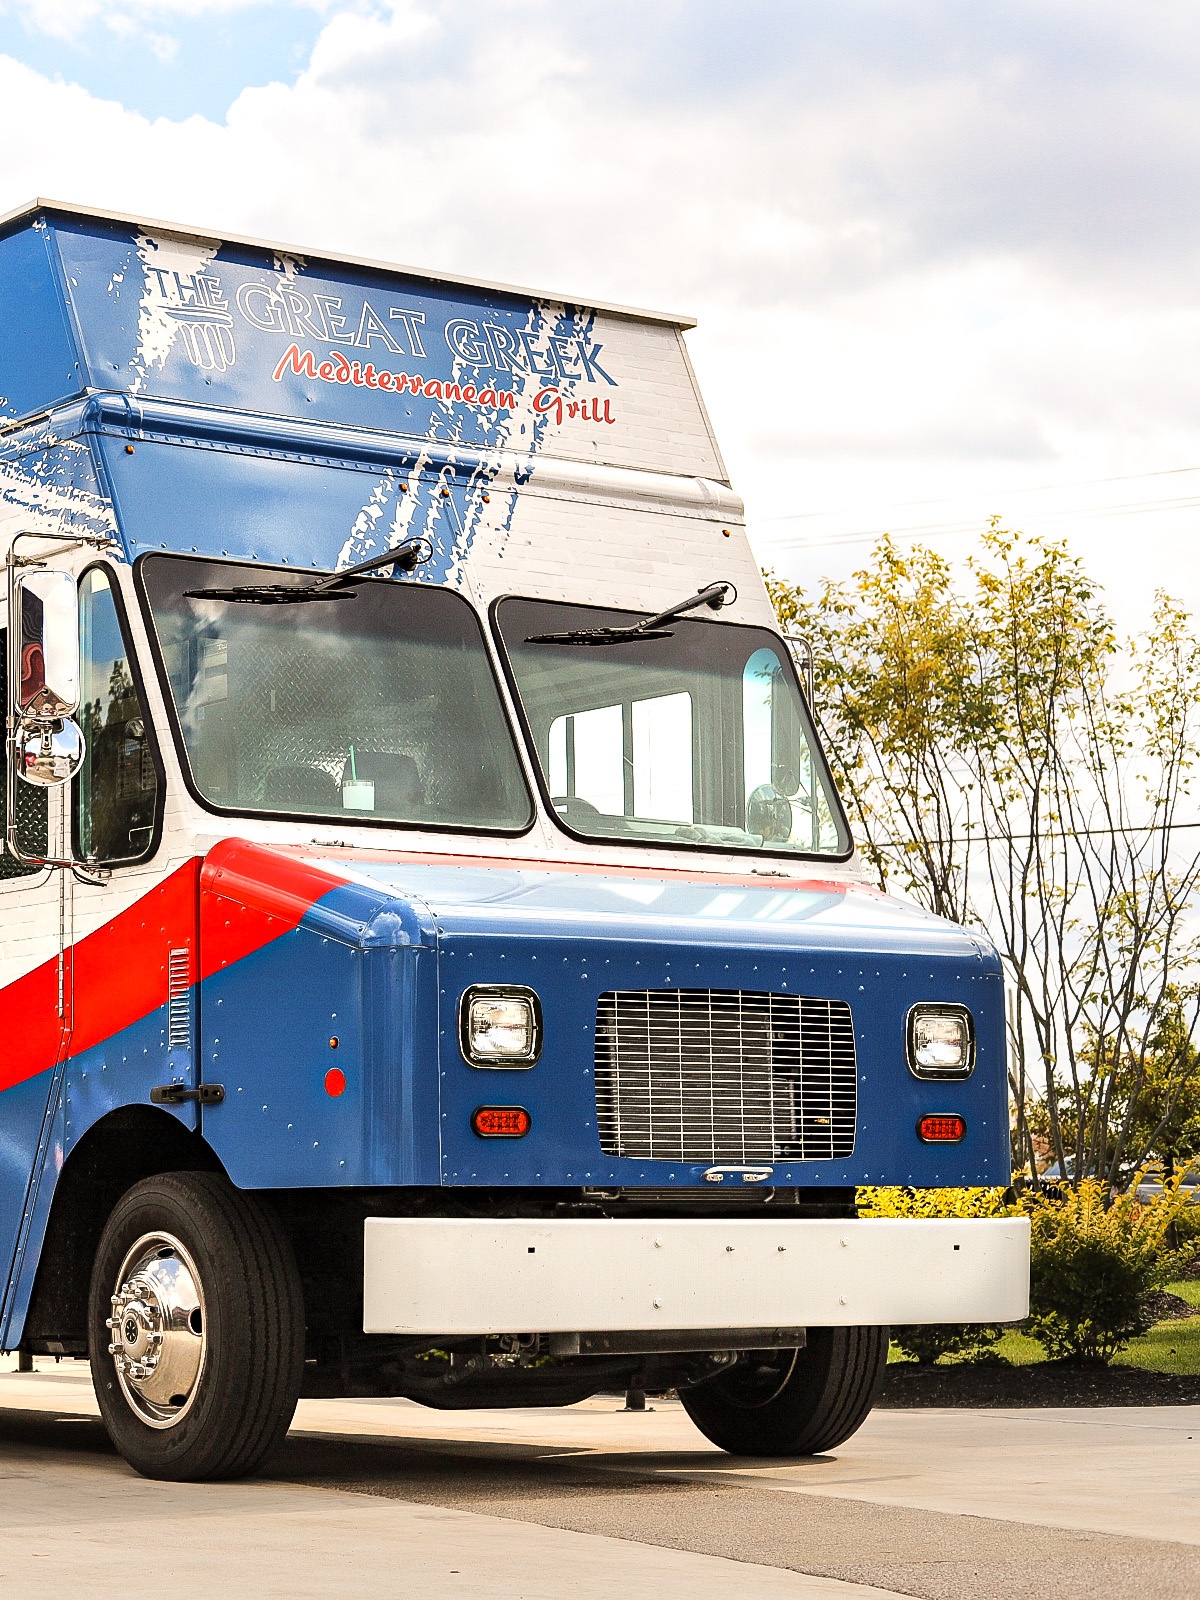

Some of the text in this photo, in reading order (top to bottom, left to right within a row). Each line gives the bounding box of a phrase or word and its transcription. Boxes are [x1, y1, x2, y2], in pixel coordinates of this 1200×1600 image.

[147, 266, 619, 386] THE GREAT GREEK
[272, 343, 616, 425] Mediterranean Grill
